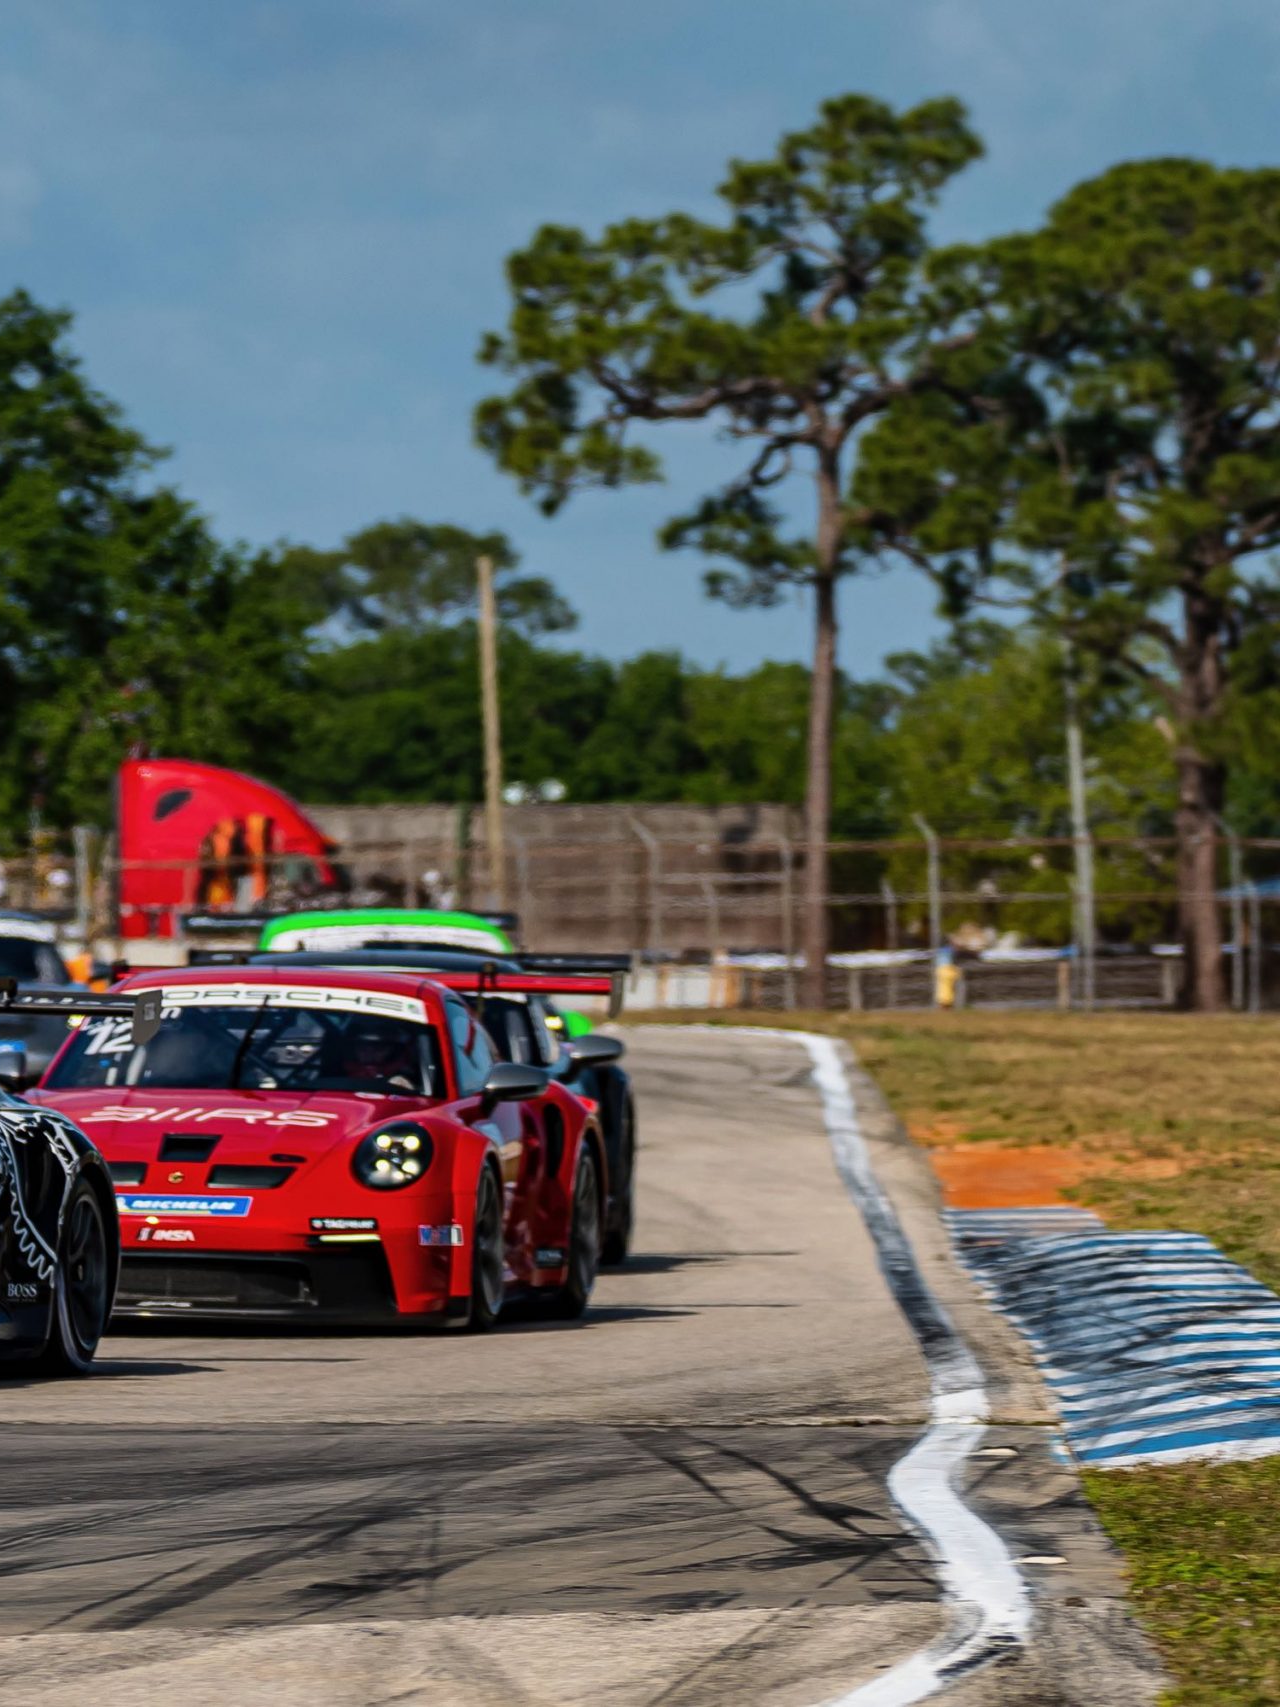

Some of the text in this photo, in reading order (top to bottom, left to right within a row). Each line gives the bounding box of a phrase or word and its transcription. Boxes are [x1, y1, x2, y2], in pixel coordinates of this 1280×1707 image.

[162, 990, 404, 1012] ORSCHE
[84, 1022, 136, 1056] 12
[131, 1199, 236, 1211] MICHELIN
[8, 1283, 38, 1298] BOSS
